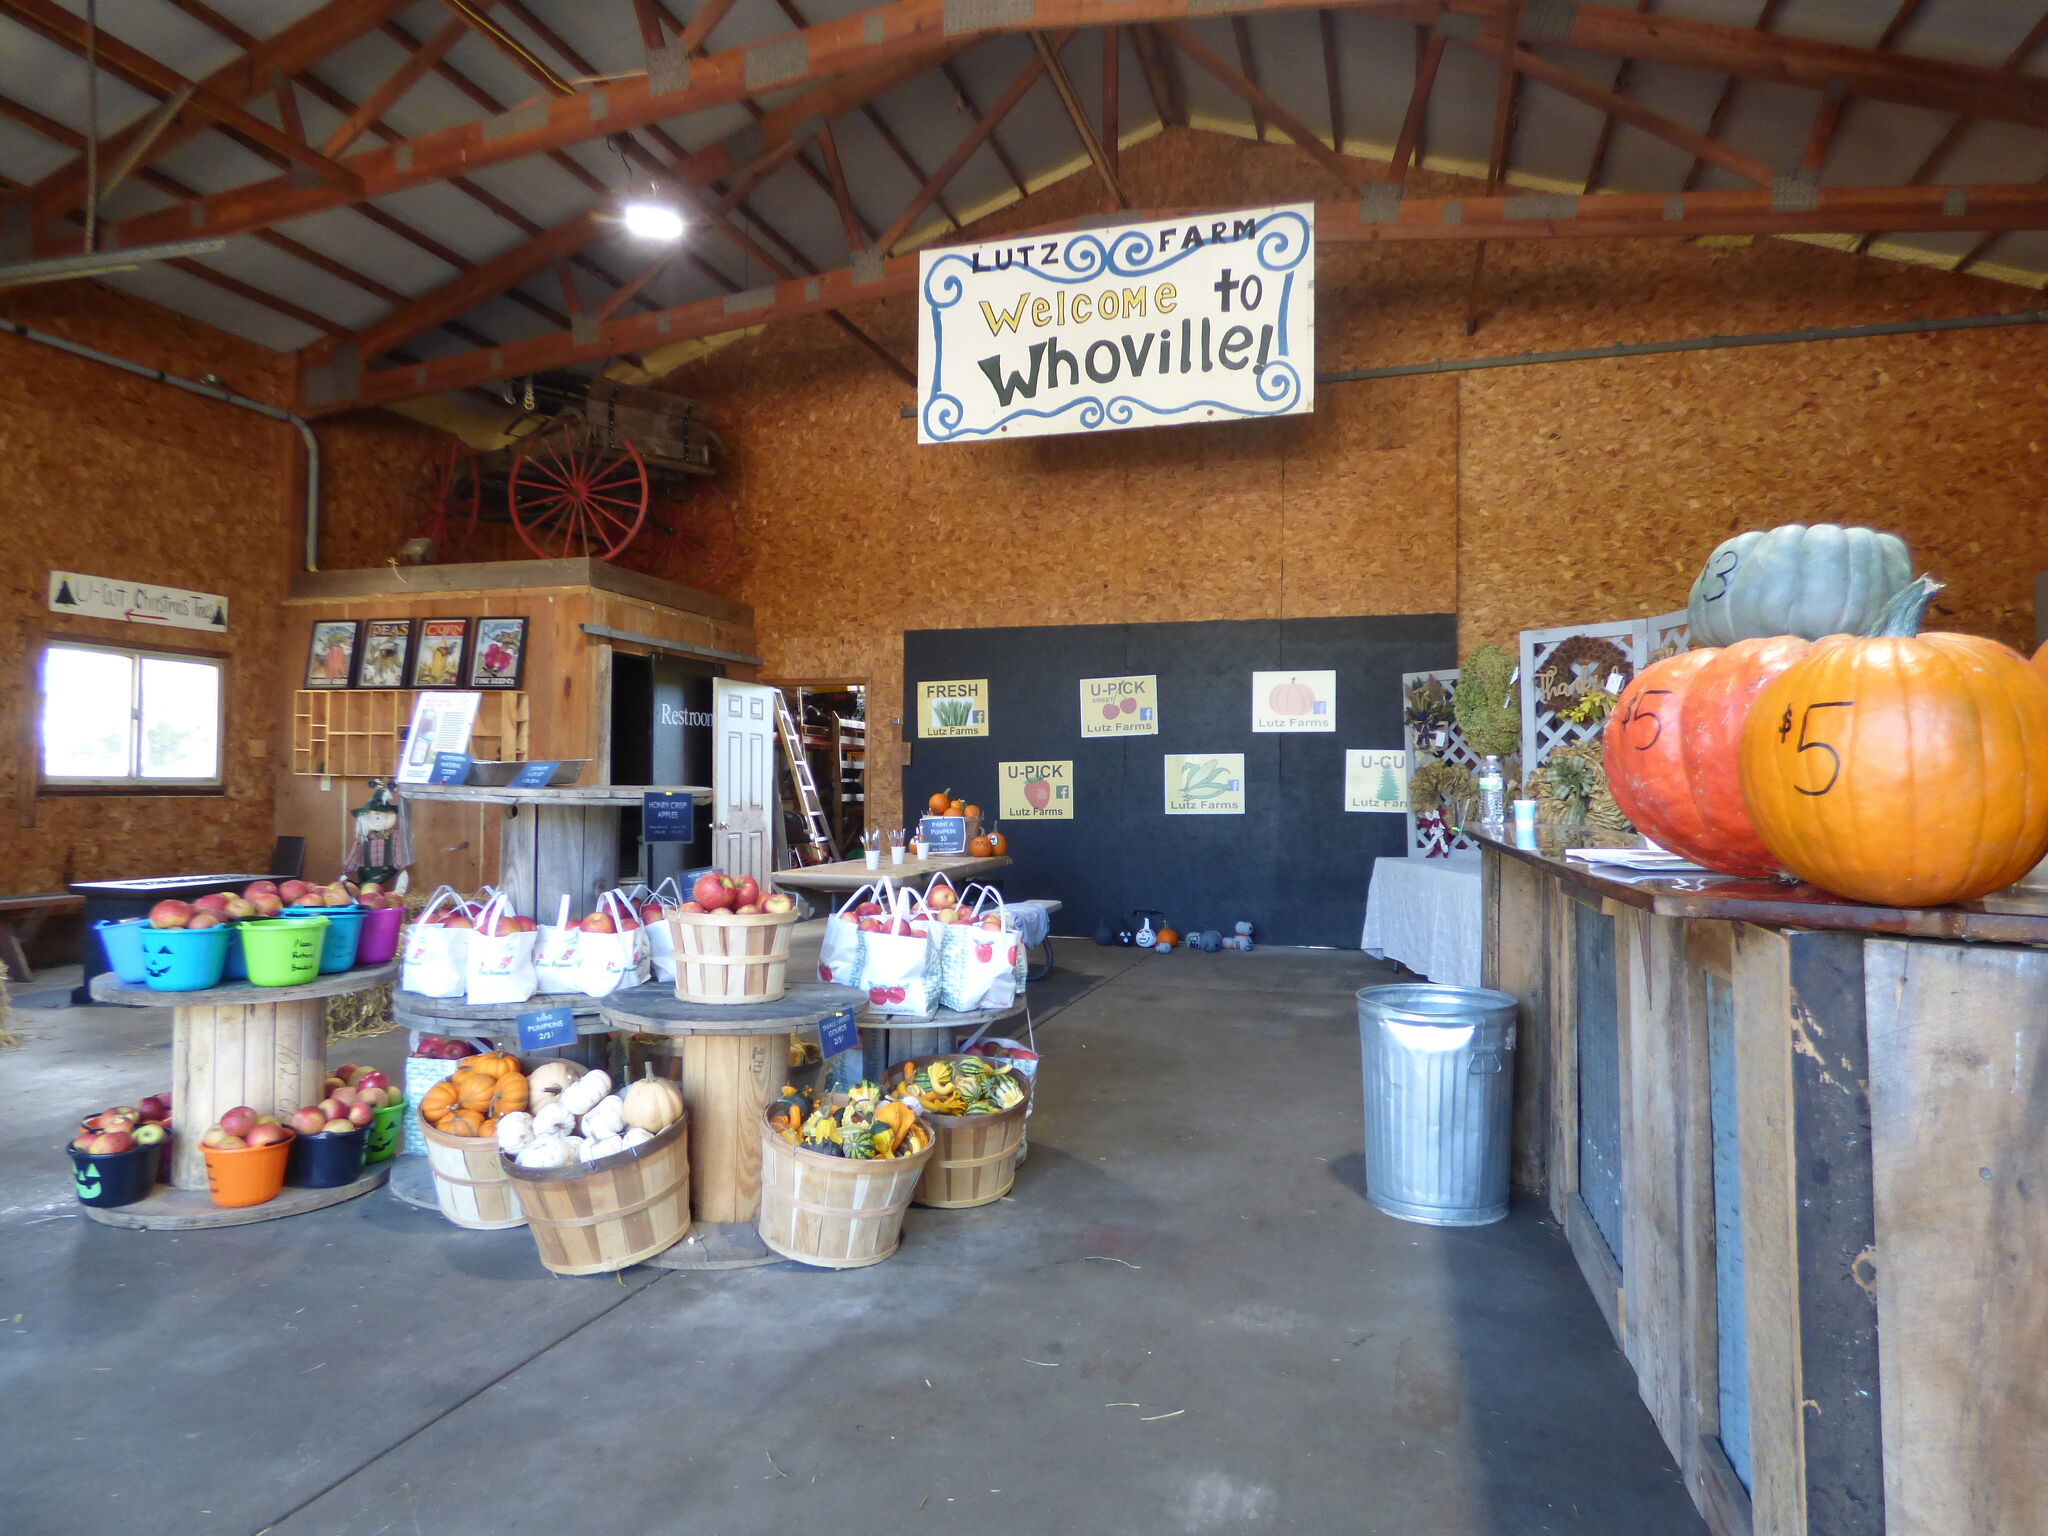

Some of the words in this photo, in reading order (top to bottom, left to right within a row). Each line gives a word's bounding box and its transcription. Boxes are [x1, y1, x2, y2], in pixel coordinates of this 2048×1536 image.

[972, 242, 1059, 274] LUTZ
[1159, 218, 1256, 252] FARM
[978, 283, 1178, 337] Welcome
[1214, 268, 1263, 312] to
[977, 317, 1274, 407] Whoville!
[371, 623, 409, 637] PEAS
[426, 623, 464, 637] CORN
[926, 684, 978, 698] FRESH
[1091, 681, 1146, 696] U-PICK
[1087, 724, 1112, 733] Lutz
[1115, 723, 1152, 731] Farms
[1258, 719, 1286, 728] Lutz
[1289, 718, 1329, 727] Farms
[927, 727, 948, 736] Lutz
[949, 726, 979, 735] Farms
[1778, 701, 1854, 796] $5
[1361, 755, 1405, 769] U-CU
[1007, 765, 1063, 779] U-PICK
[648, 801, 669, 809] HONEY
[670, 801, 687, 809] CRISP
[1170, 801, 1197, 810] Lutz
[1200, 801, 1239, 809] Farms
[1352, 798, 1380, 807] Lutz
[1384, 799, 1408, 808] Far
[657, 811, 678, 819] APPLES
[1009, 808, 1031, 817] Lutz
[1033, 807, 1063, 816] Farms
[527, 1020, 564, 1032] PUMPKINS
